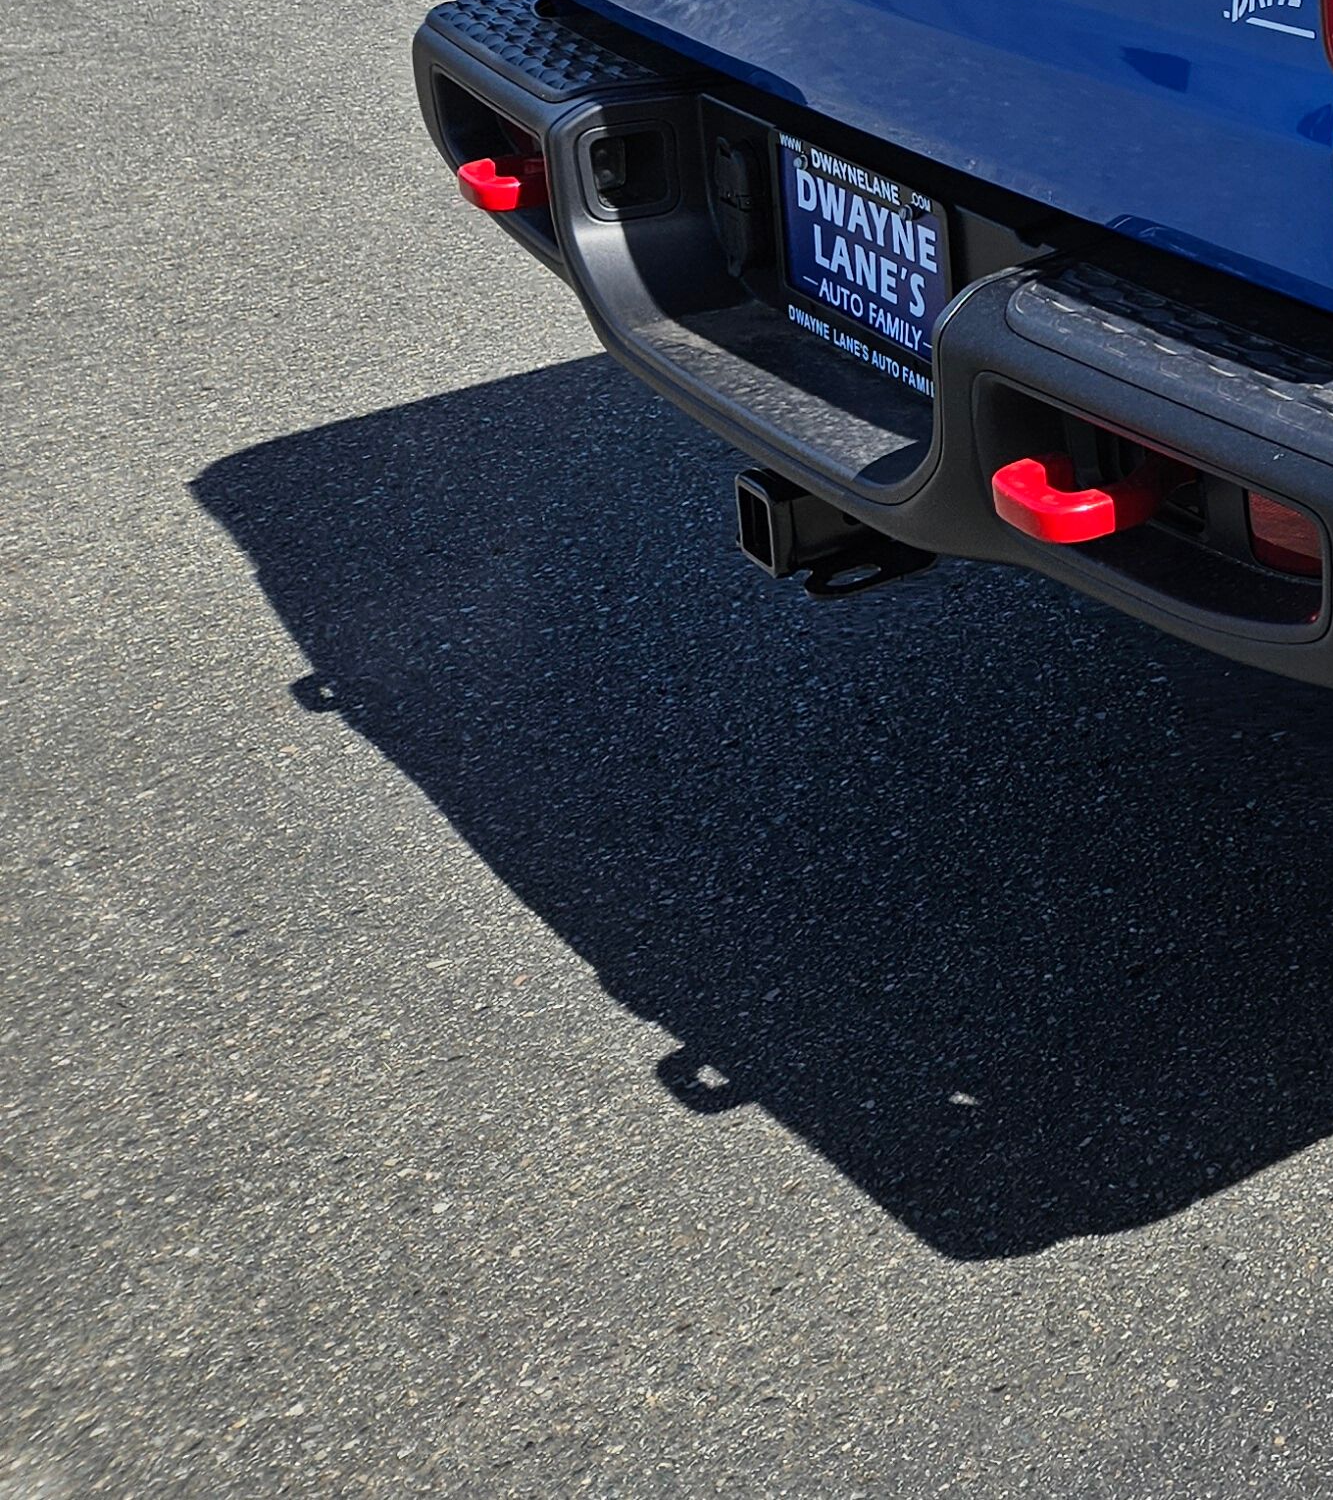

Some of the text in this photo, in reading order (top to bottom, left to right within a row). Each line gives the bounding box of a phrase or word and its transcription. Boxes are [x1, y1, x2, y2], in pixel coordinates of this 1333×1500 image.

[810, 148, 901, 205] DWAYNELANE
[796, 168, 938, 273] DWAYNE
[813, 224, 926, 318] LANE'S
[788, 304, 830, 341] DWAYNE
[833, 328, 869, 362] LANE'S
[871, 350, 900, 378] AUTO
[819, 278, 923, 351] AUTO FAMILY
